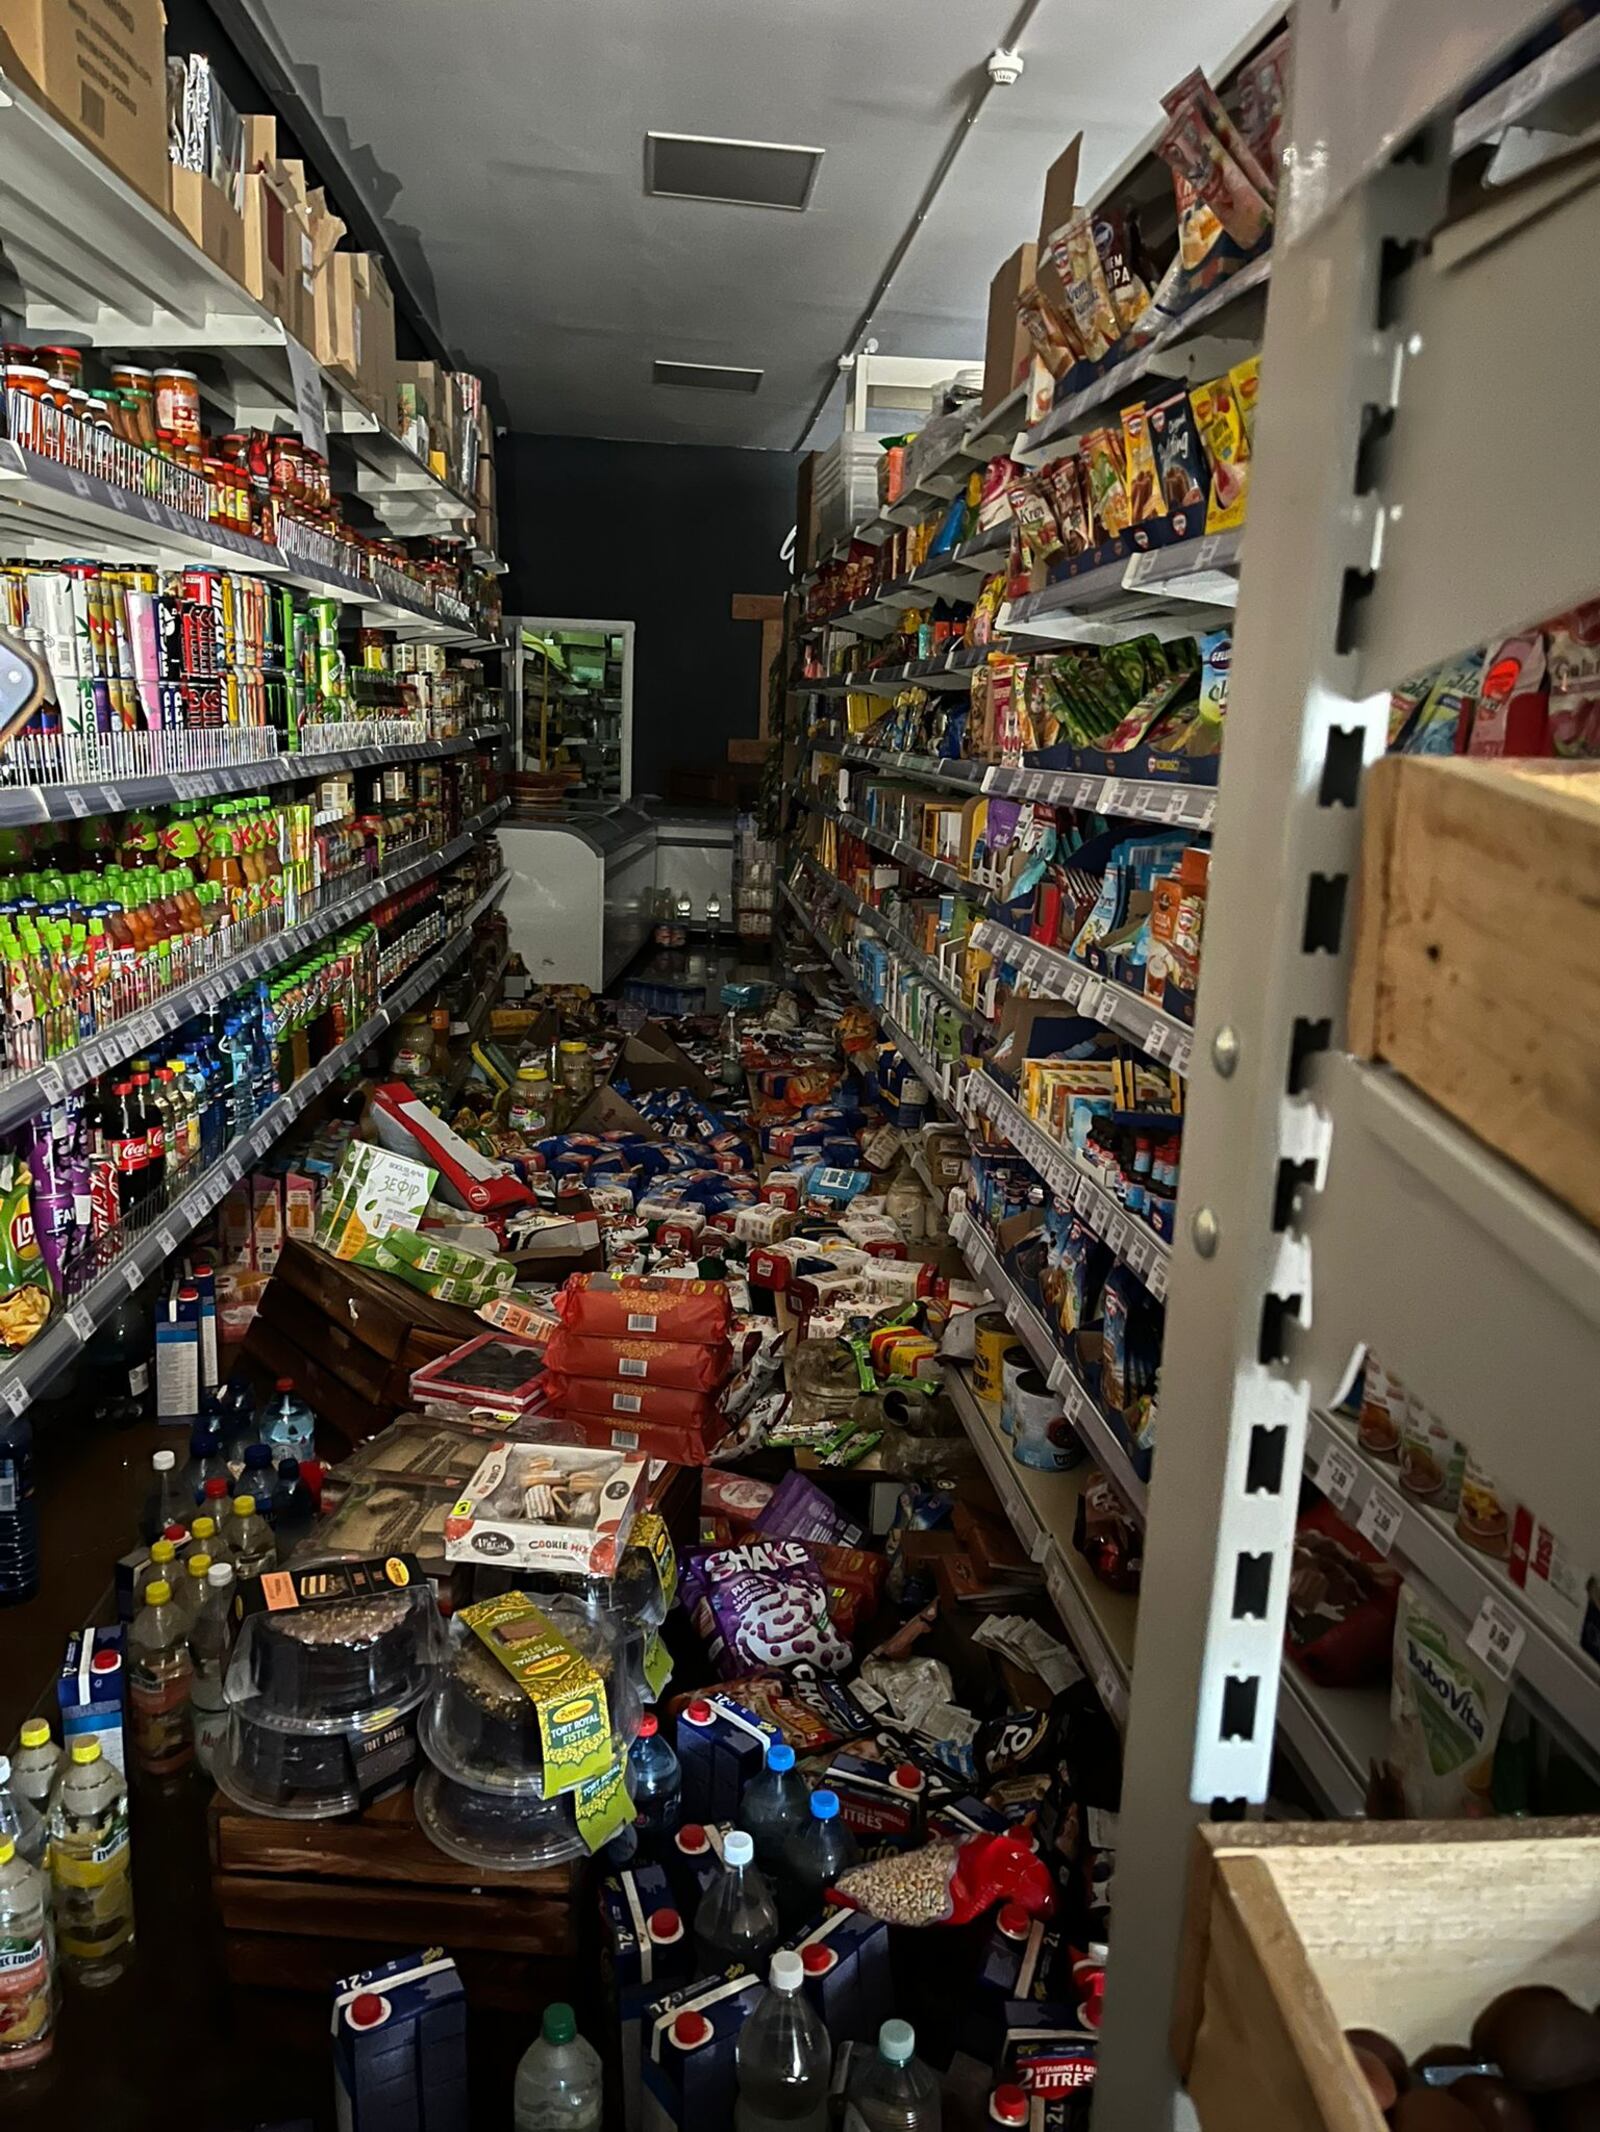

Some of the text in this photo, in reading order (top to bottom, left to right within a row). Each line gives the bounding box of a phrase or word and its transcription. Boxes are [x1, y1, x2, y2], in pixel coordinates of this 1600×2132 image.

[704, 1540, 810, 1583] SHAKE
[550, 1713, 600, 1739] TORT ROYAL
[562, 1726, 591, 1745] FISTIC
[1034, 2071, 1095, 2090] LITRES
